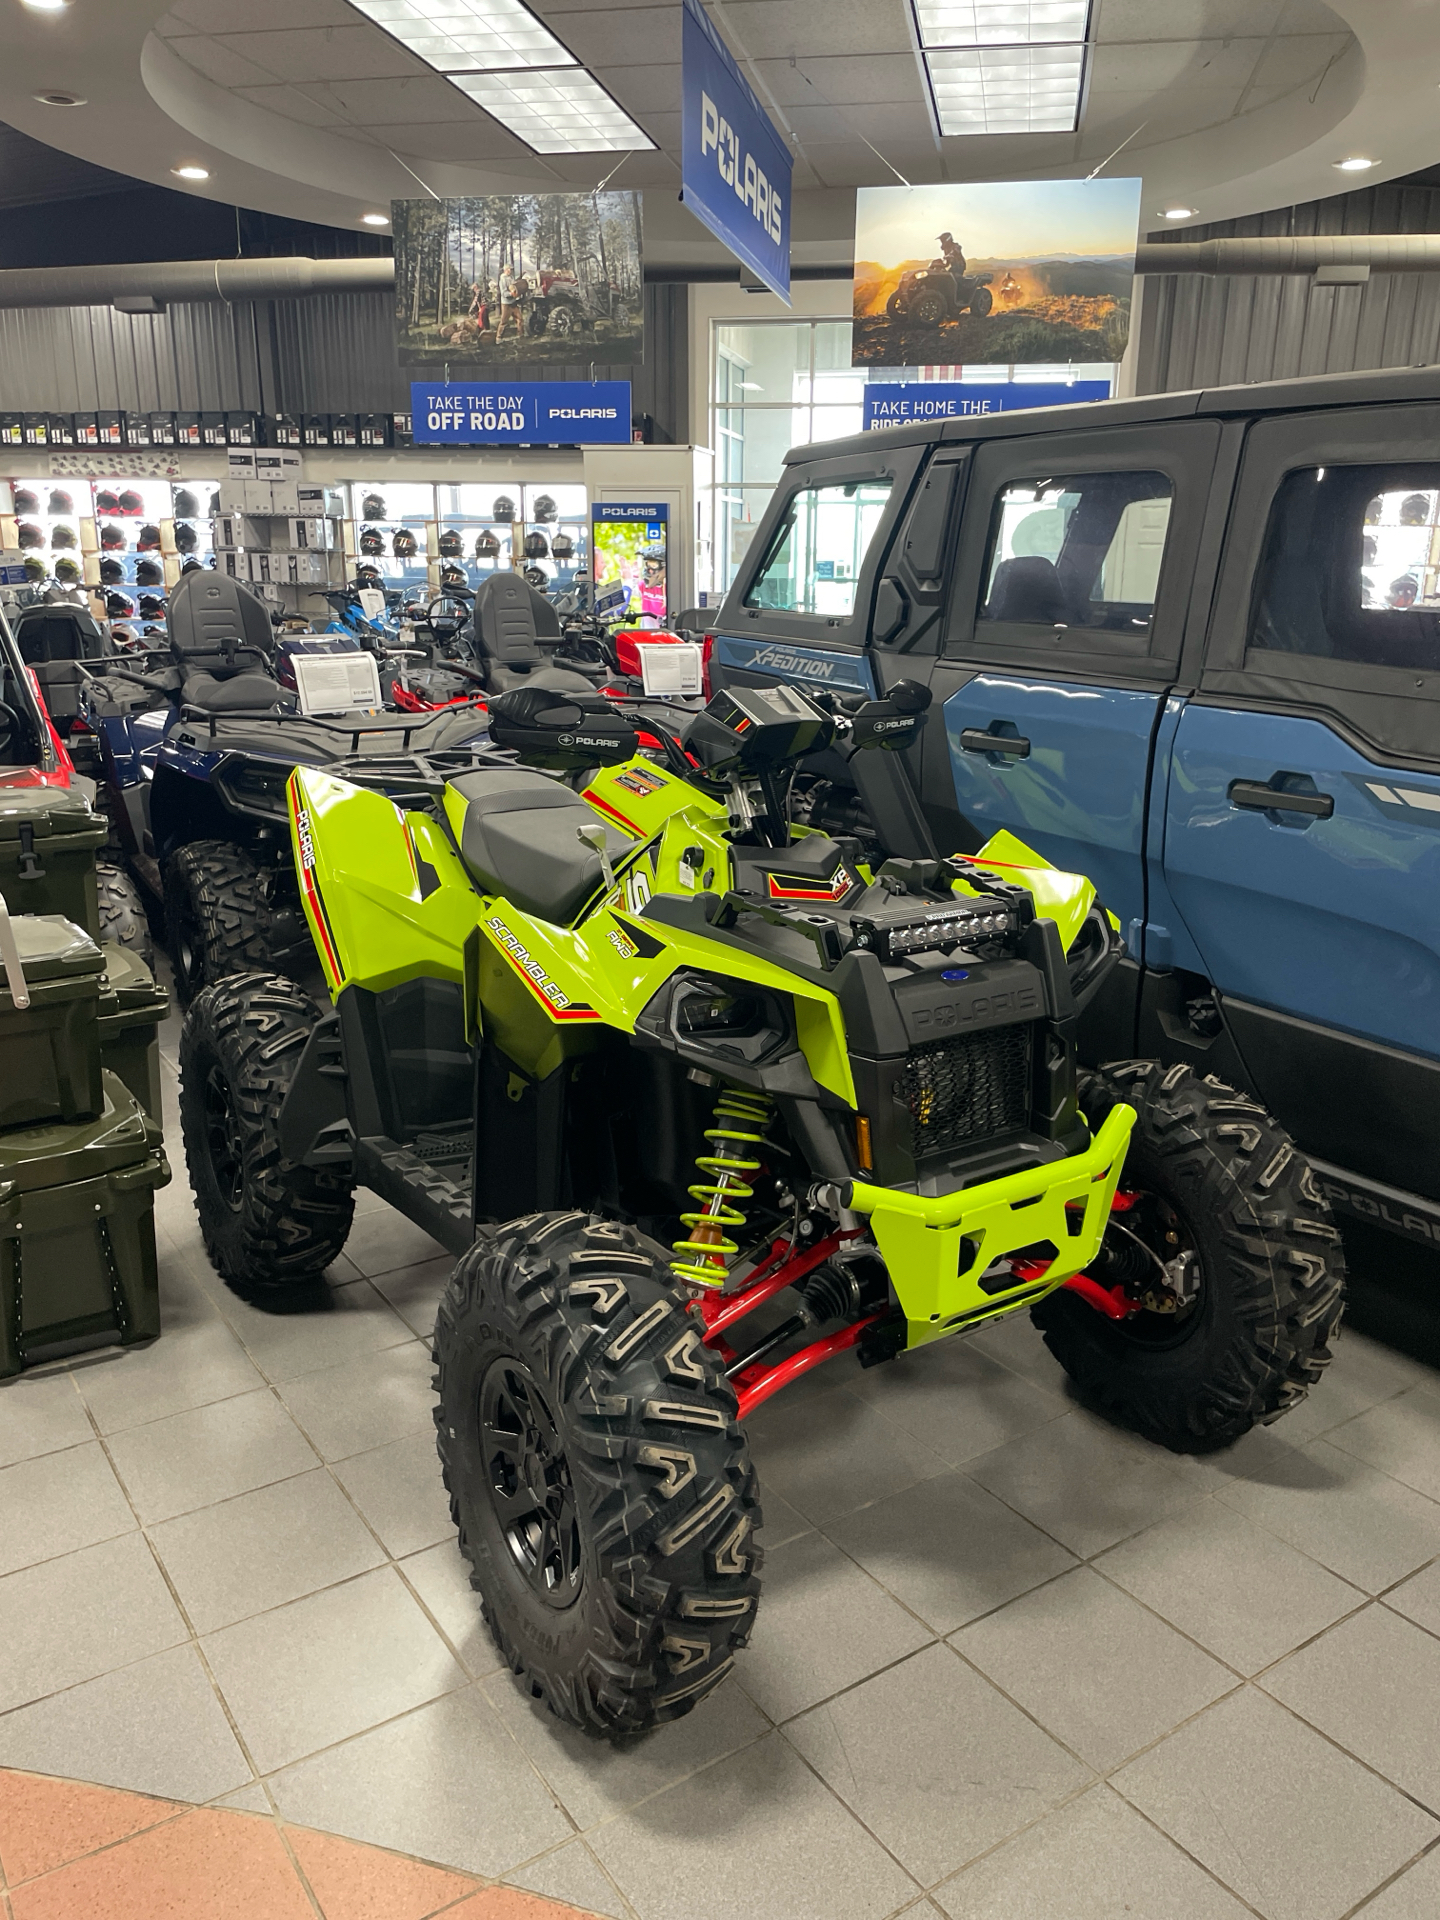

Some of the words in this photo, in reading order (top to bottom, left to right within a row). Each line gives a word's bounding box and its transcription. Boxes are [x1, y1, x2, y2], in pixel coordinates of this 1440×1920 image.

[701, 90, 782, 246] POLARIS
[427, 396, 463, 410] TAKE
[467, 396, 494, 410] THE
[498, 396, 524, 410] DAY
[549, 408, 618, 419] POLARIS
[871, 401, 910, 415] TAKE
[914, 401, 957, 415] HOME
[961, 400, 991, 414] THE
[427, 412, 465, 431] OFF
[470, 412, 525, 431] ROAD
[602, 508, 657, 516] POLARIS
[744, 645, 834, 677] XPEDITION
[885, 718, 915, 729] POLARIS
[575, 737, 619, 748] POLARIS
[296, 809, 316, 870] POLARIS
[605, 930, 633, 960] AWD
[487, 916, 570, 1009] SCRAMBLER
[911, 987, 1039, 1030] POLARIS
[1322, 1181, 1440, 1241] POLA
